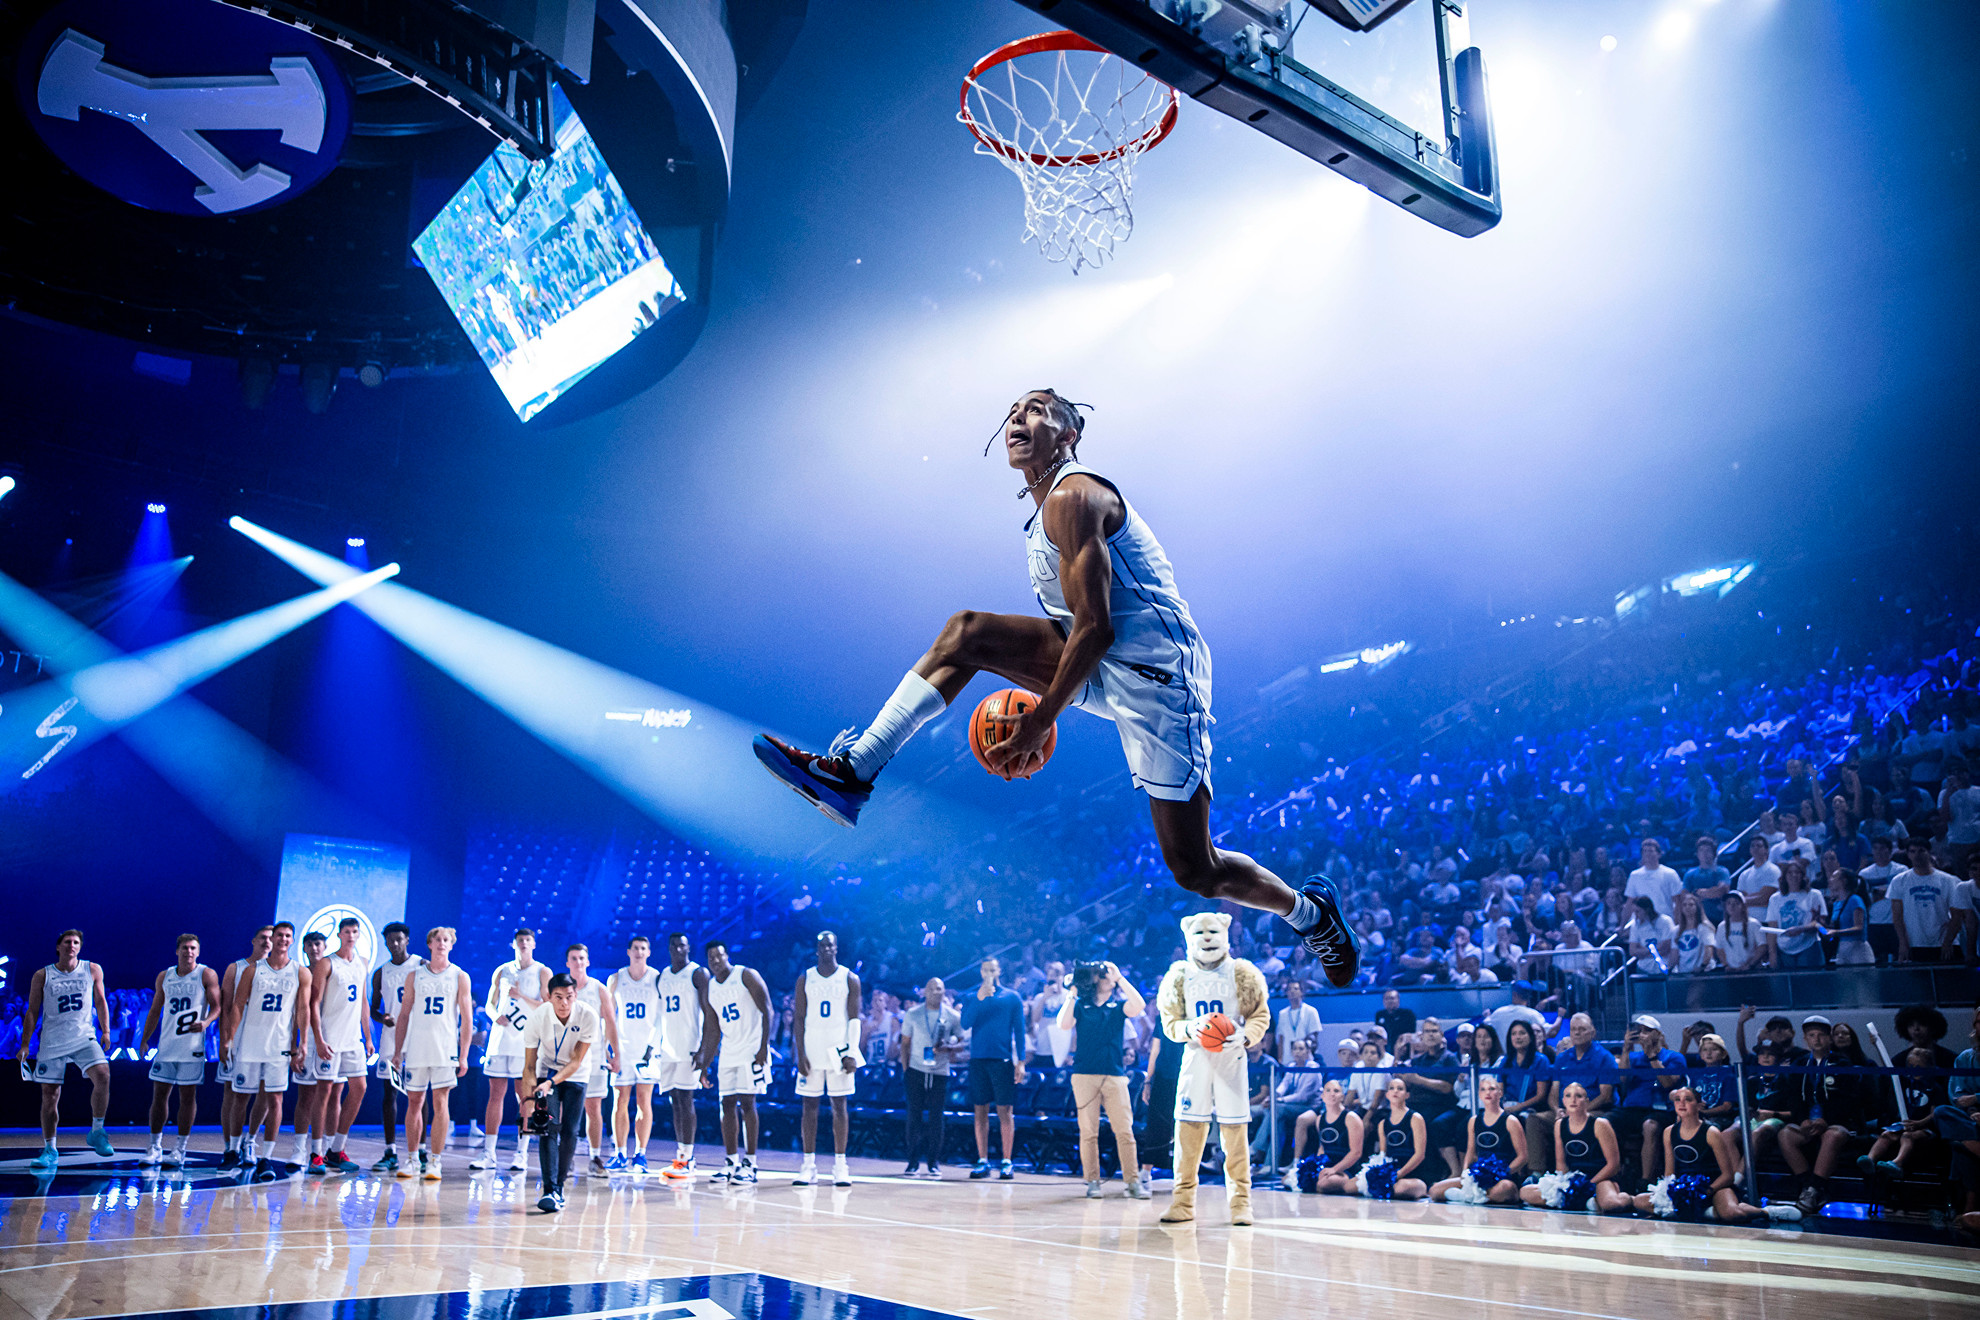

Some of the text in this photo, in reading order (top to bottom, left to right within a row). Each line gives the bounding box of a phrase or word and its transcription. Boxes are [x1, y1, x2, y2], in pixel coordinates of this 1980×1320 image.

[51, 980, 87, 996] BYU
[258, 979, 292, 993] BYU
[347, 984, 357, 1002] 3
[1188, 981, 1229, 998] BYU
[58, 993, 83, 1014] 25
[169, 997, 191, 1015] 30
[261, 993, 283, 1012] 21
[424, 996, 444, 1015] 15
[625, 1002, 646, 1019] 20
[666, 995, 680, 1013] 13
[820, 1000, 831, 1018] 0
[1195, 999, 1224, 1018] 00
[722, 1002, 740, 1023] 45
[175, 1011, 198, 1035] 8
